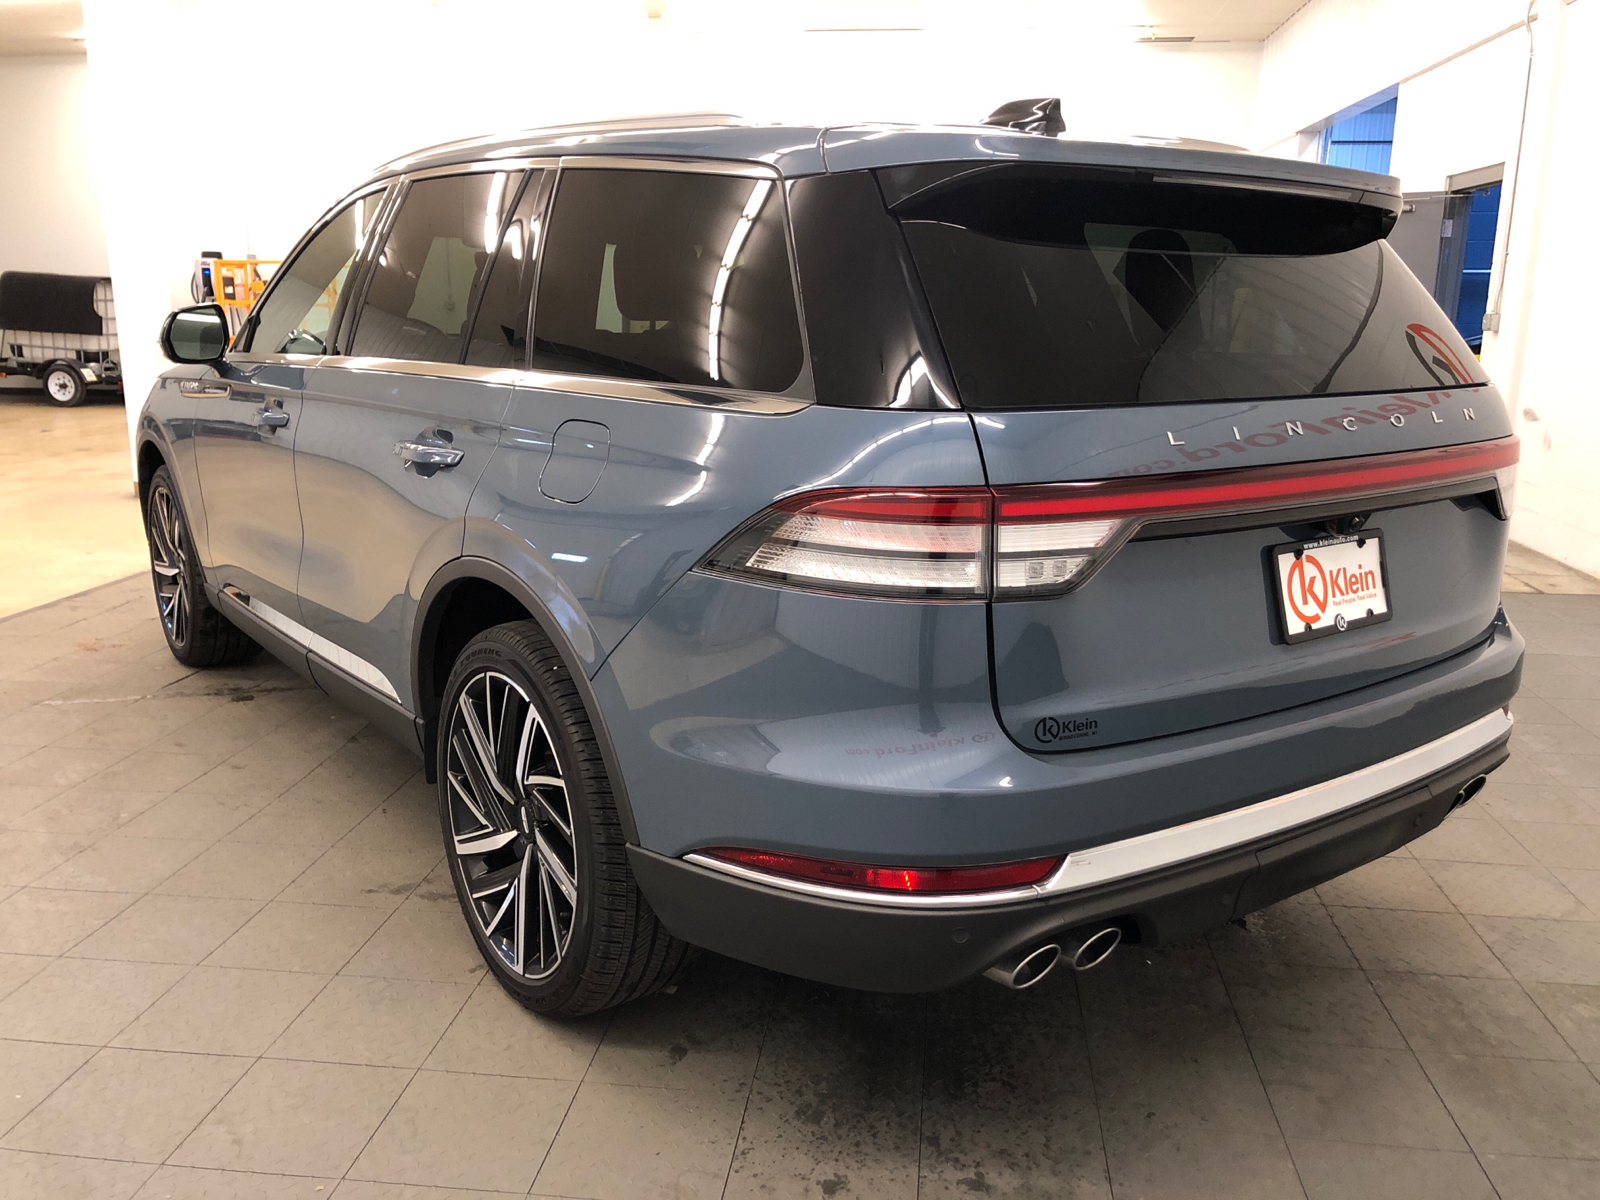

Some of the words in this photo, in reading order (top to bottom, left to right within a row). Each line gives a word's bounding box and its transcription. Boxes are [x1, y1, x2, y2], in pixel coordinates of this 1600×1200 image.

[1166, 407, 1475, 446] LINCOLN
[1303, 535, 1359, 549] www.kleinauto.com
[1329, 564, 1377, 598] Klein
[1062, 718, 1098, 733] Klein
